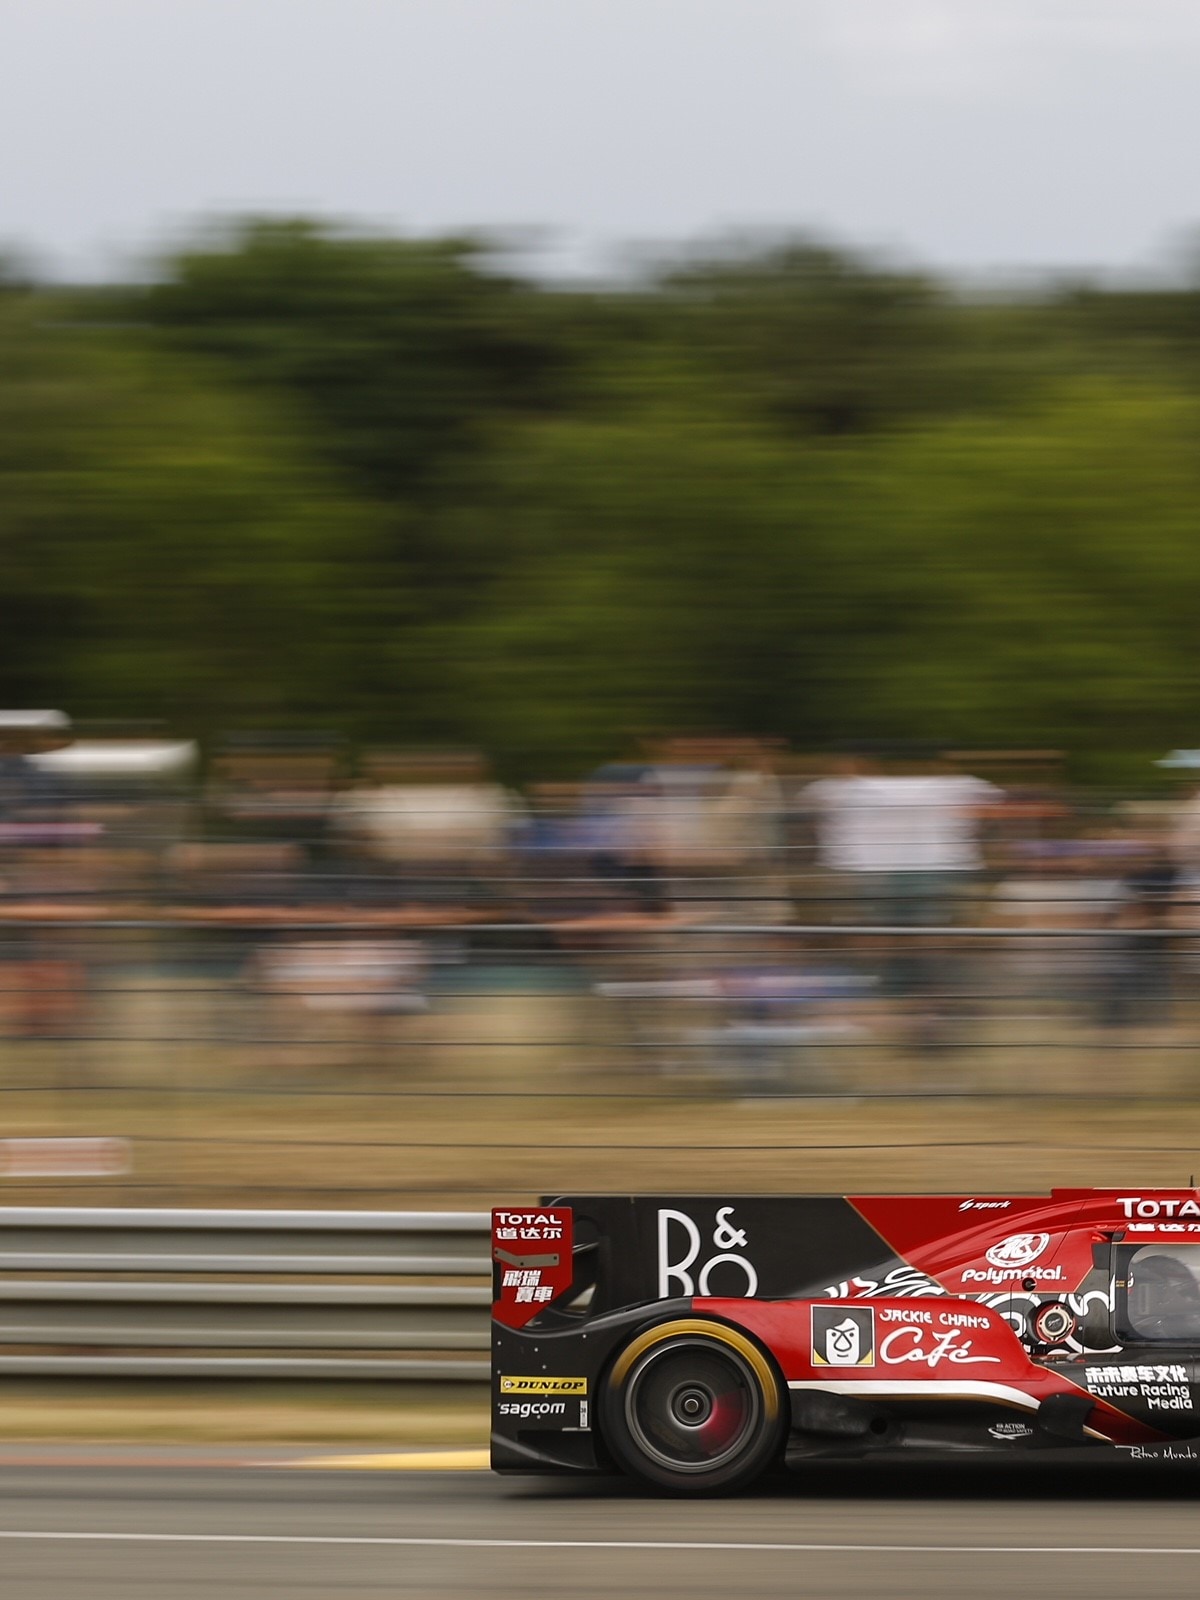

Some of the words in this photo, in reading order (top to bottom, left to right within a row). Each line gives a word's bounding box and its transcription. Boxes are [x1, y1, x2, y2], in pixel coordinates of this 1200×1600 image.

[495, 1212, 562, 1225] TOTAL
[495, 1227, 562, 1239] 道达尔
[879, 1308, 933, 1324] JACKIE
[939, 1312, 991, 1330] CHAN'S
[879, 1326, 1001, 1368] Café
[517, 1381, 584, 1390] DUNLOP
[1087, 1384, 1139, 1396] Future
[1140, 1383, 1190, 1399] Racing
[500, 1402, 566, 1418] sagcom
[1147, 1396, 1194, 1410] Media
[1163, 1446, 1198, 1459] Mundo
